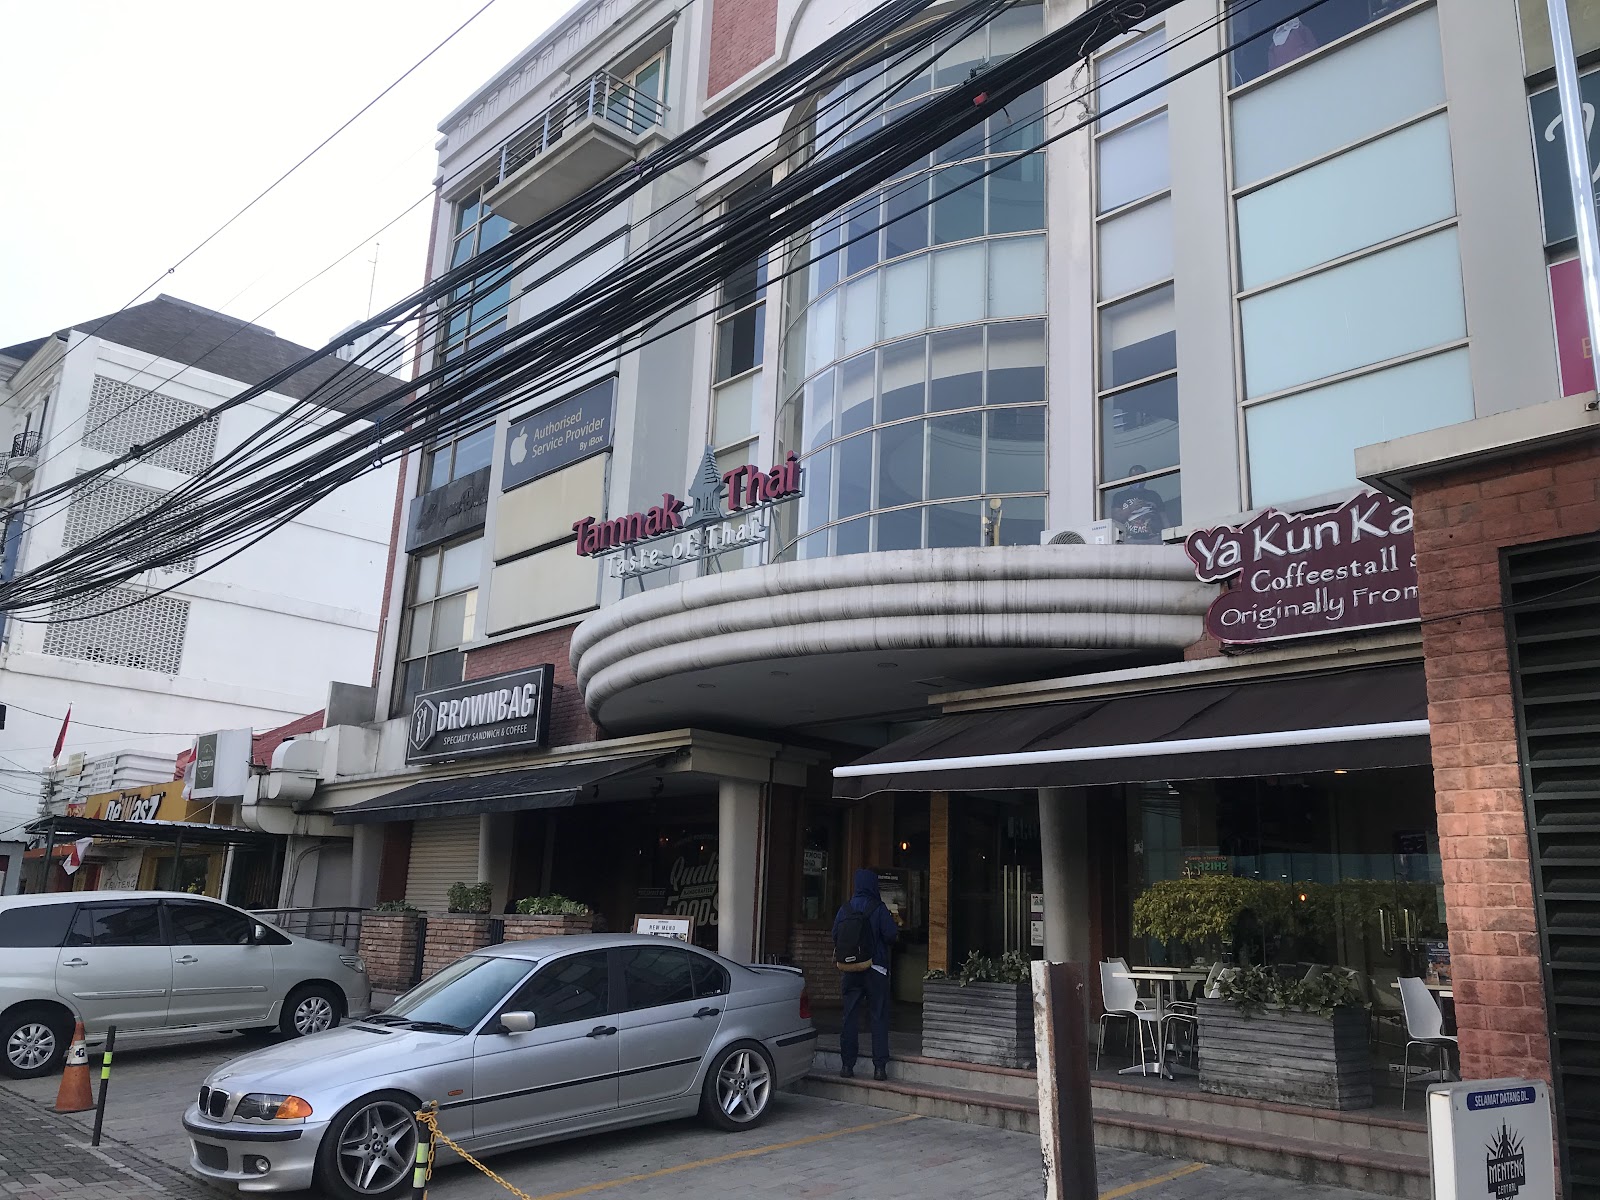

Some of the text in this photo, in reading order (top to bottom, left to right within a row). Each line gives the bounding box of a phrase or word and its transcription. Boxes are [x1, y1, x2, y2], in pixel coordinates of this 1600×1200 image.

[532, 417, 605, 458] Service Provider
[533, 408, 583, 441] Authorised
[579, 435, 604, 451] By iBox
[573, 450, 800, 556] Tamnak Thai
[606, 546, 663, 579] Taste
[705, 514, 766, 551] Thai
[1195, 534, 1242, 570] Ya
[1253, 520, 1341, 562] Kun
[1251, 545, 1399, 593] Coffeestall
[1221, 587, 1344, 630] Originally
[437, 683, 537, 732] BROWNBAG
[443, 724, 528, 745] SPECIALTY SANDWICH & COFFEE
[670, 851, 719, 892] Quali
[1475, 1093, 1500, 1107] SELAMAT
[1500, 1091, 1521, 1104] DATANG
[1489, 1158, 1524, 1184] MENTENG
